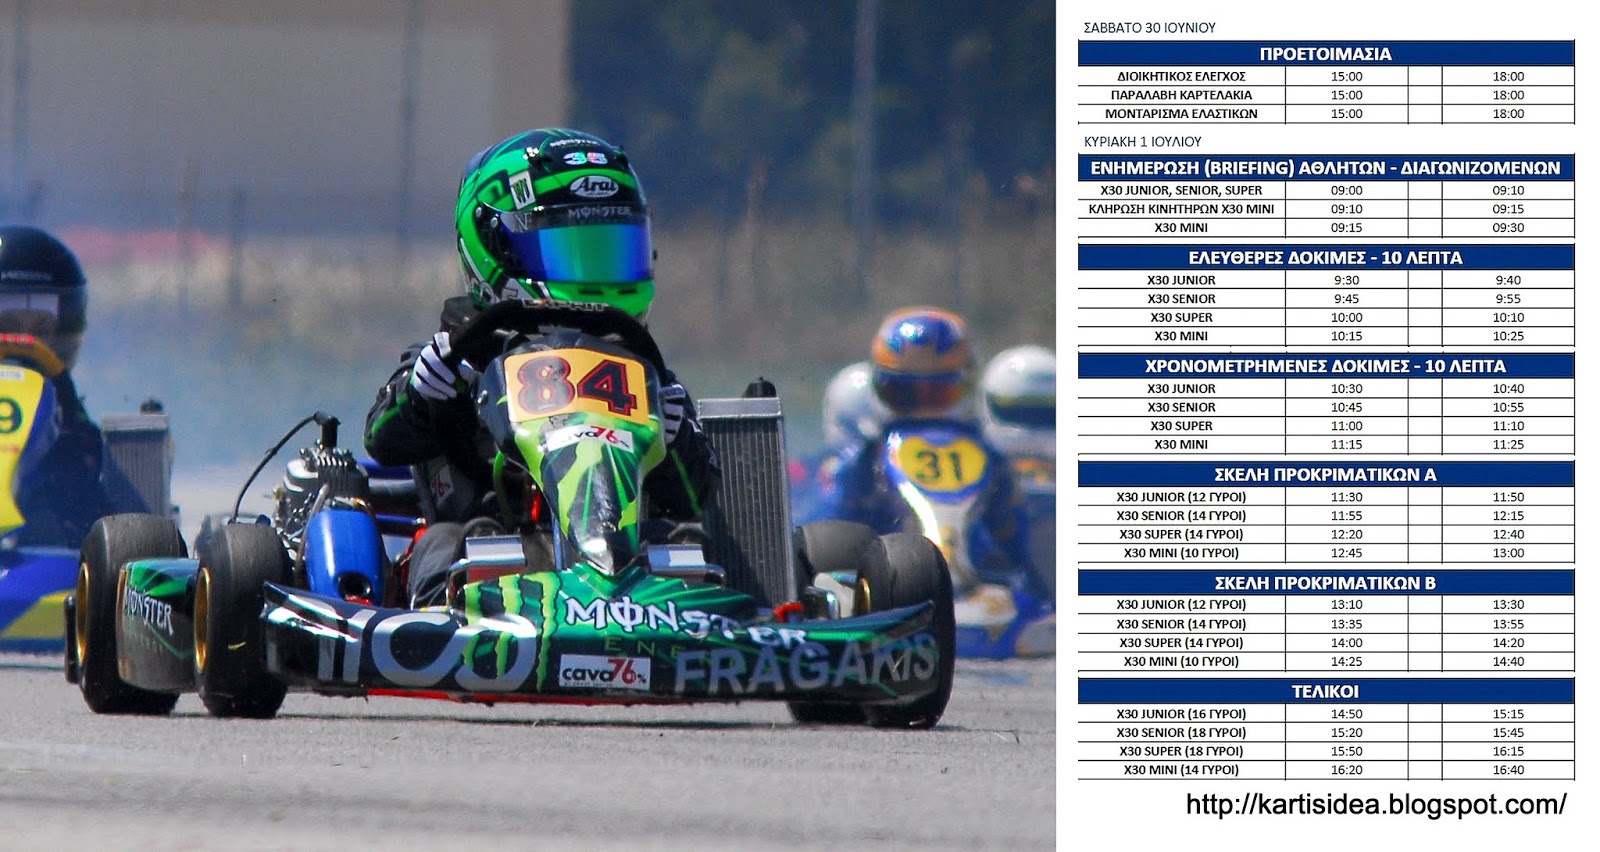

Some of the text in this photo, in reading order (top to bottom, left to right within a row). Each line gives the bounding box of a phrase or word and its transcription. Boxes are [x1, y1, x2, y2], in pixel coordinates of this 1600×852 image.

[572, 177, 616, 192] Arai
[516, 355, 638, 417] 84
[912, 449, 964, 485] 31
[122, 586, 175, 637] MONSTER
[674, 632, 940, 697] FRAGAKIS
